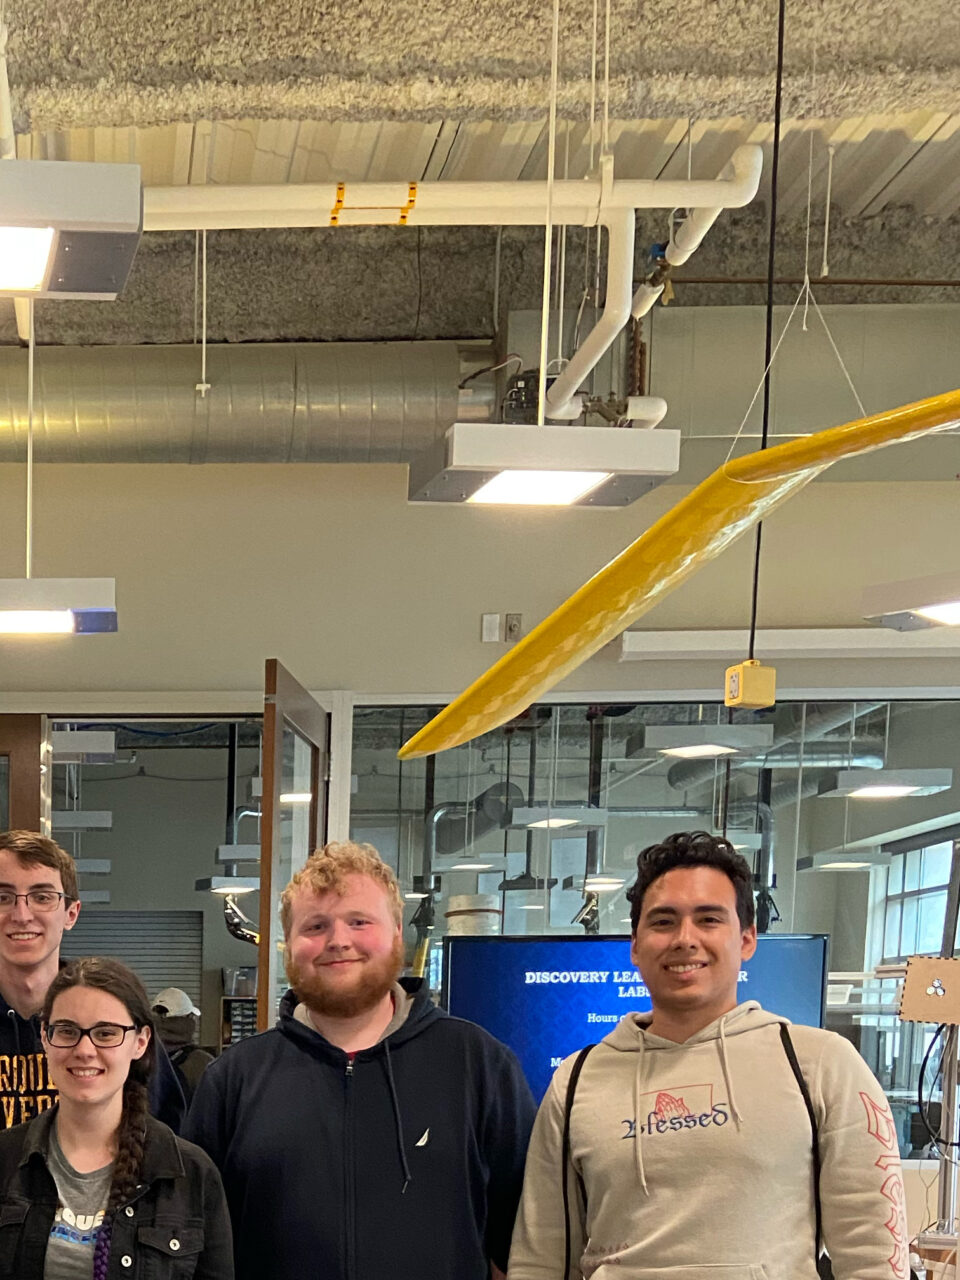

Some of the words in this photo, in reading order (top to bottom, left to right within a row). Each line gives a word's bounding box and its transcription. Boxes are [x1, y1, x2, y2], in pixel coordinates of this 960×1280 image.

[525, 971, 609, 983] DISCOVERY
[613, 971, 644, 982] LEA
[587, 1013, 618, 1023] Hours
